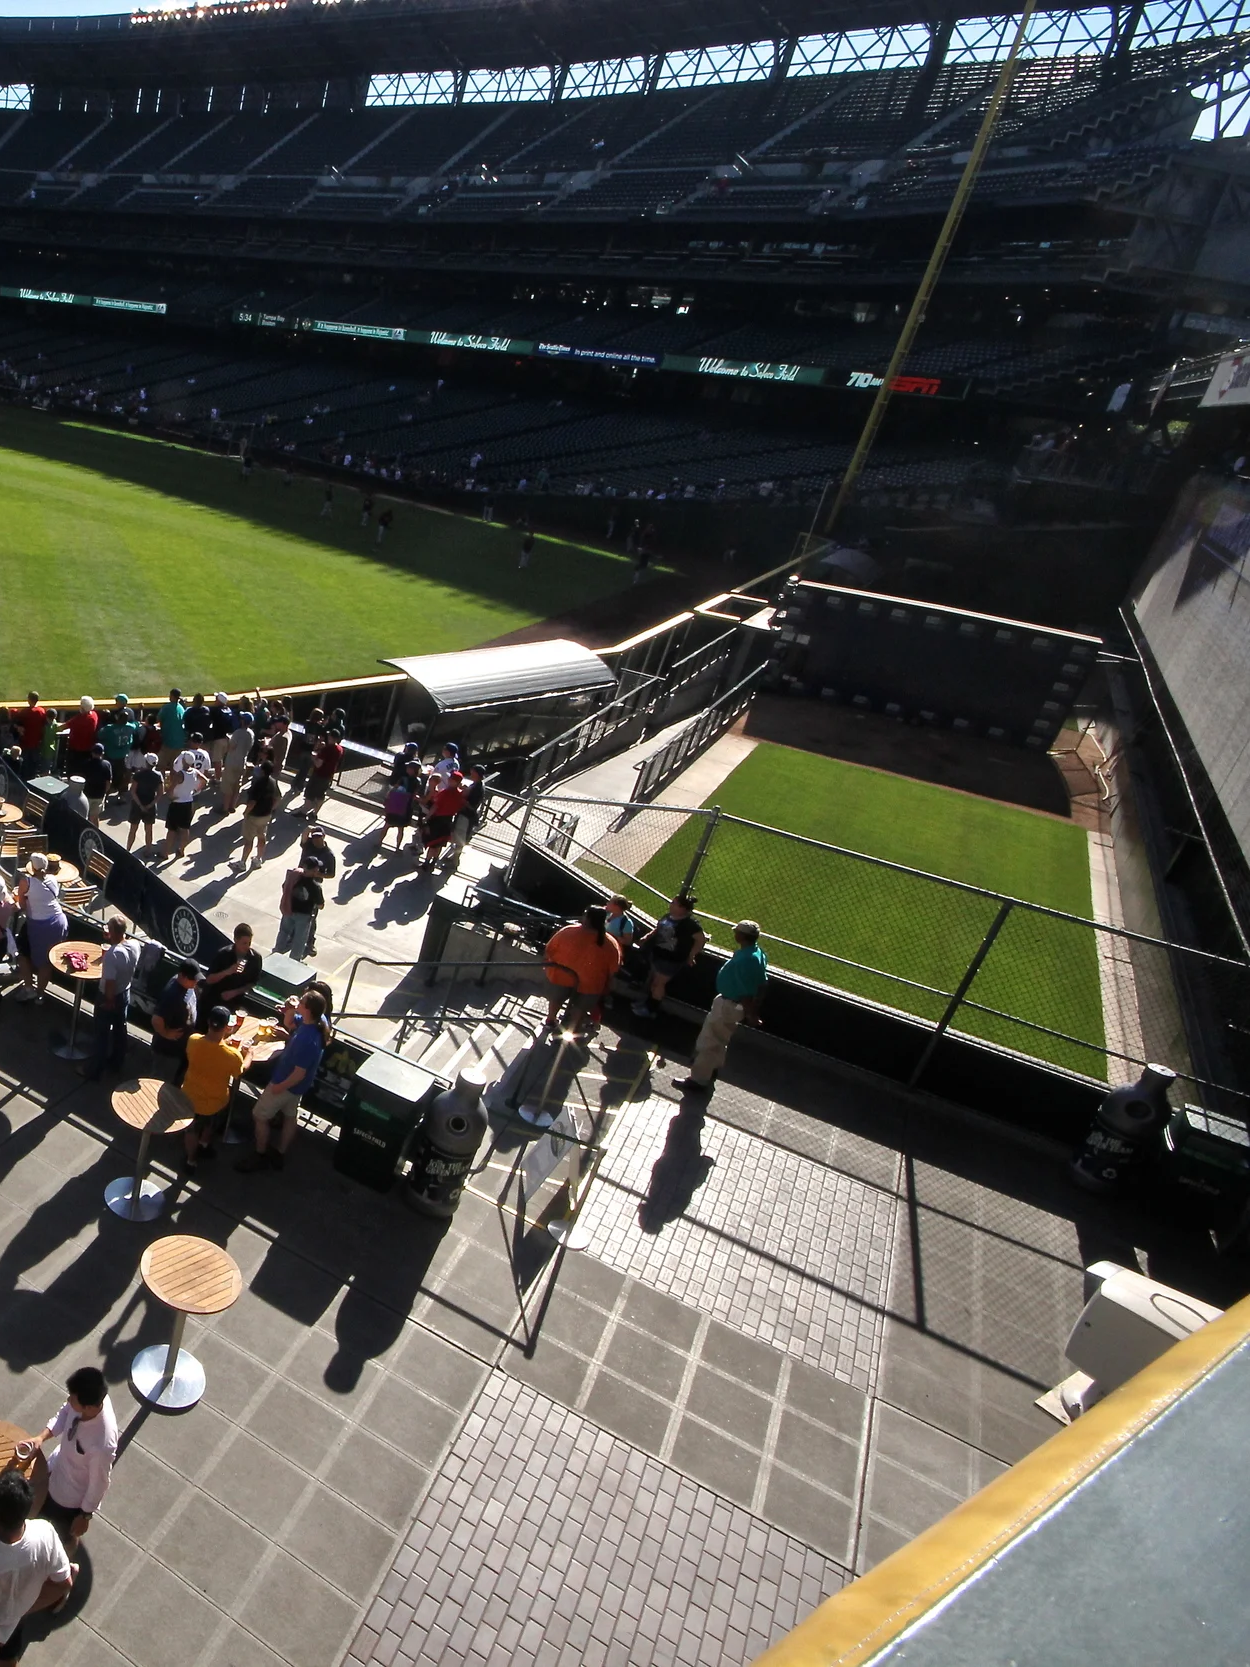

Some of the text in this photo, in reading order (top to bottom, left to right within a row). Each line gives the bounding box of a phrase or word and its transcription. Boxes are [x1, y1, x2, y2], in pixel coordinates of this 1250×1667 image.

[239, 313, 252, 322] 5:34
[430, 331, 456, 346] Welcome
[463, 334, 487, 349] Safeco
[487, 337, 511, 351] Field
[580, 350, 594, 358] print
[606, 352, 622, 360] online
[631, 354, 640, 362] the
[641, 355, 656, 363] time.
[698, 357, 800, 381] Welcome to Safeco Field
[846, 371, 874, 388] 710
[888, 375, 941, 395] ESPN
[353, 1127, 372, 1141] SAFECO
[372, 1136, 387, 1149] FIELD
